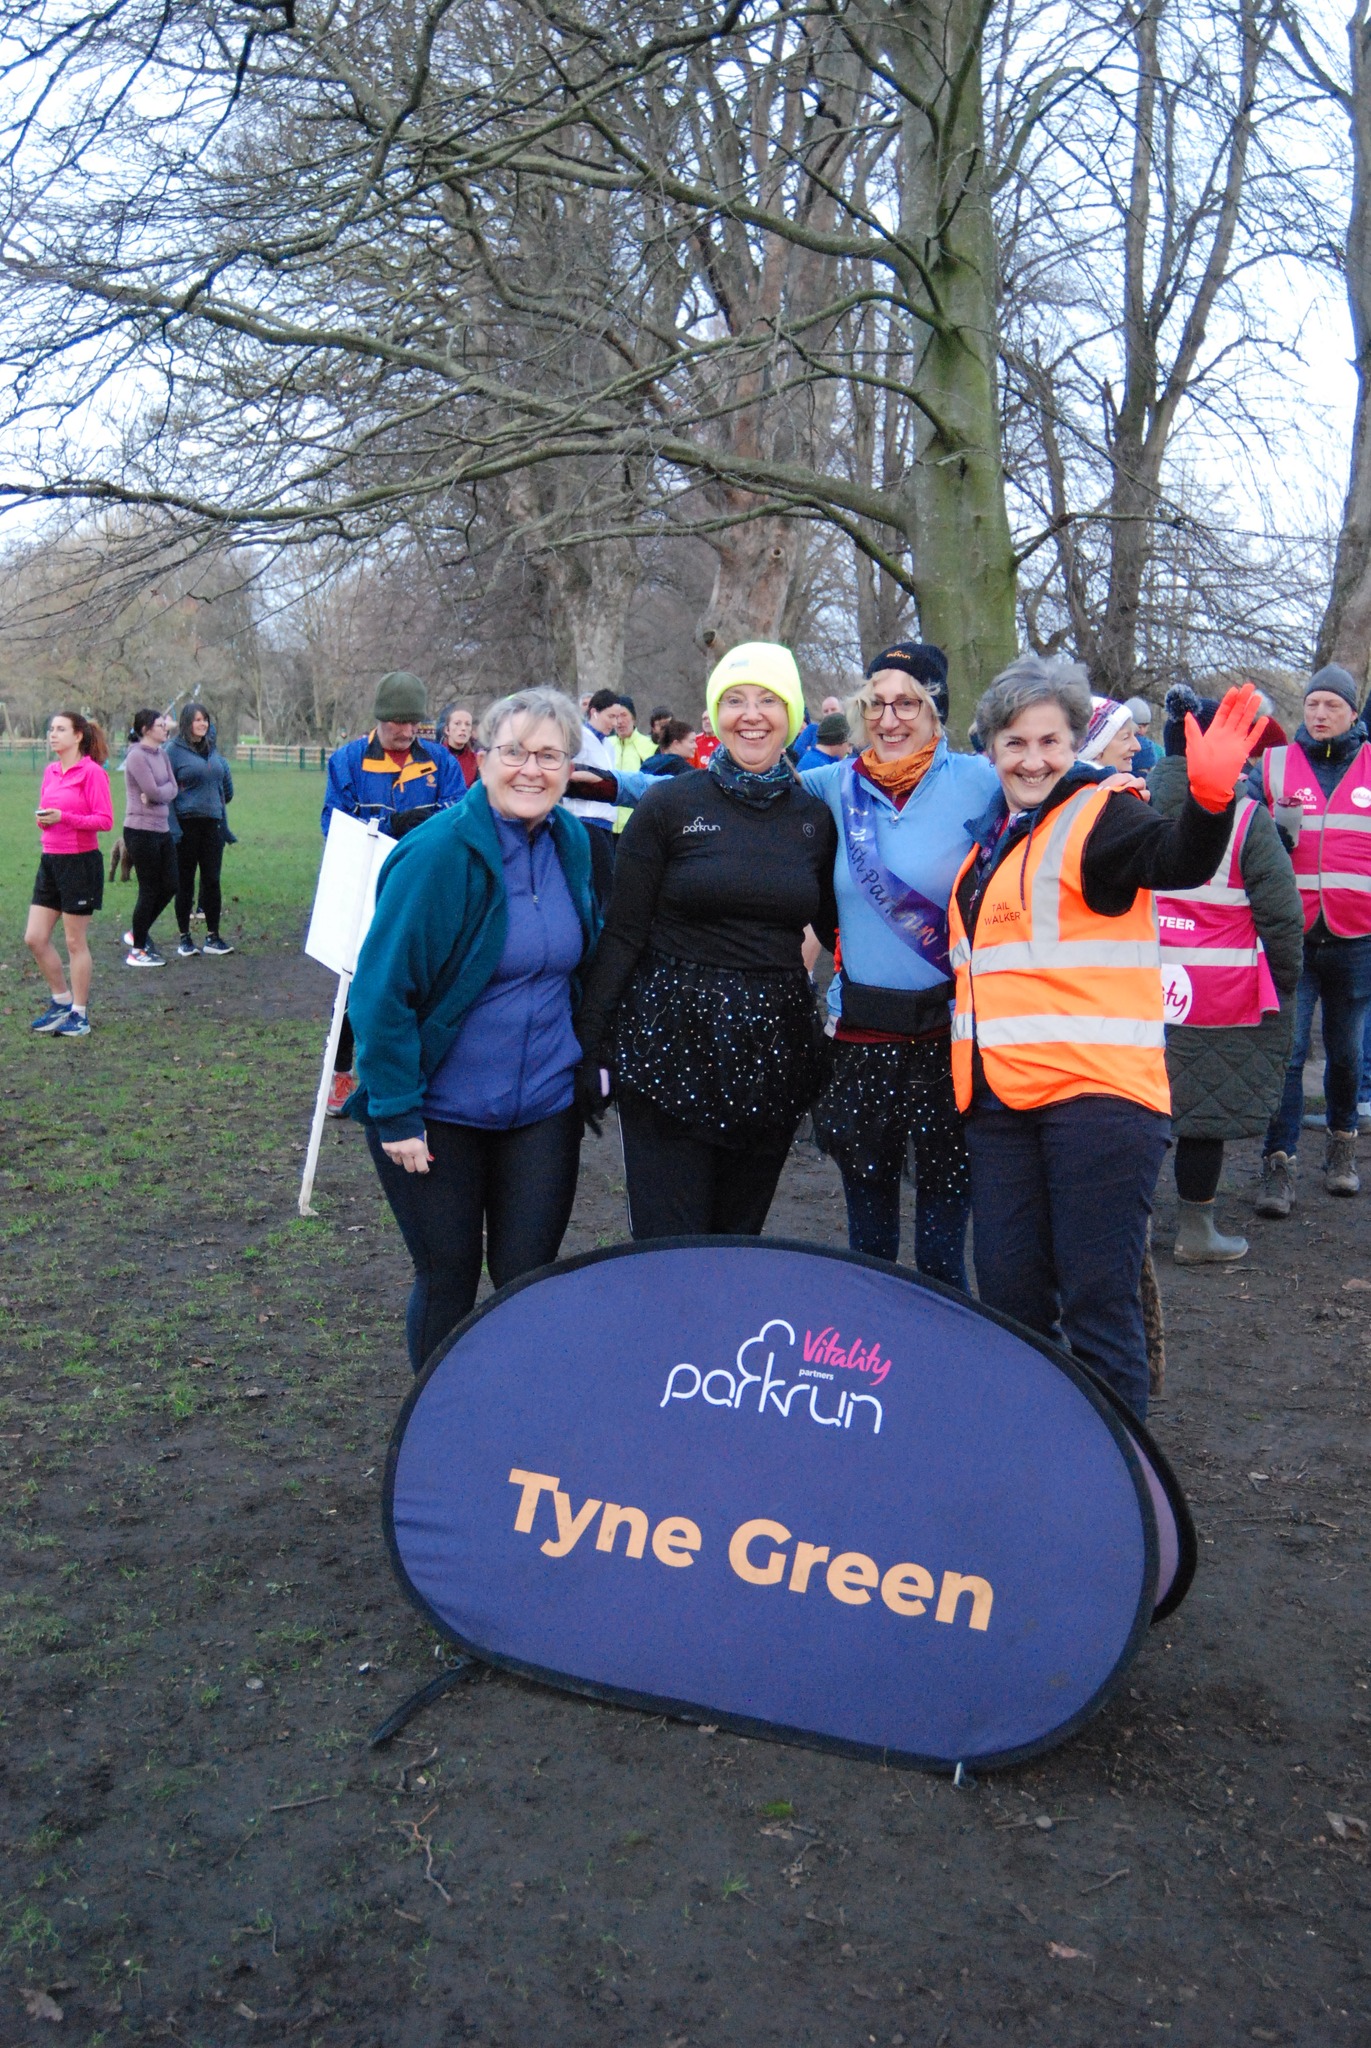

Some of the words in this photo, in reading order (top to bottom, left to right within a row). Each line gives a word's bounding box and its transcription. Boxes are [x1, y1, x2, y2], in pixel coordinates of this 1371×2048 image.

[682, 816, 721, 834] parkrun
[992, 901, 1010, 913] TAIL
[984, 911, 1021, 926] WALKER
[802, 1326, 892, 1386] Vitality
[659, 1318, 883, 1435] parkrun
[798, 1368, 835, 1381] partners
[508, 1468, 703, 1568] Tyne
[728, 1518, 995, 1631] Green
